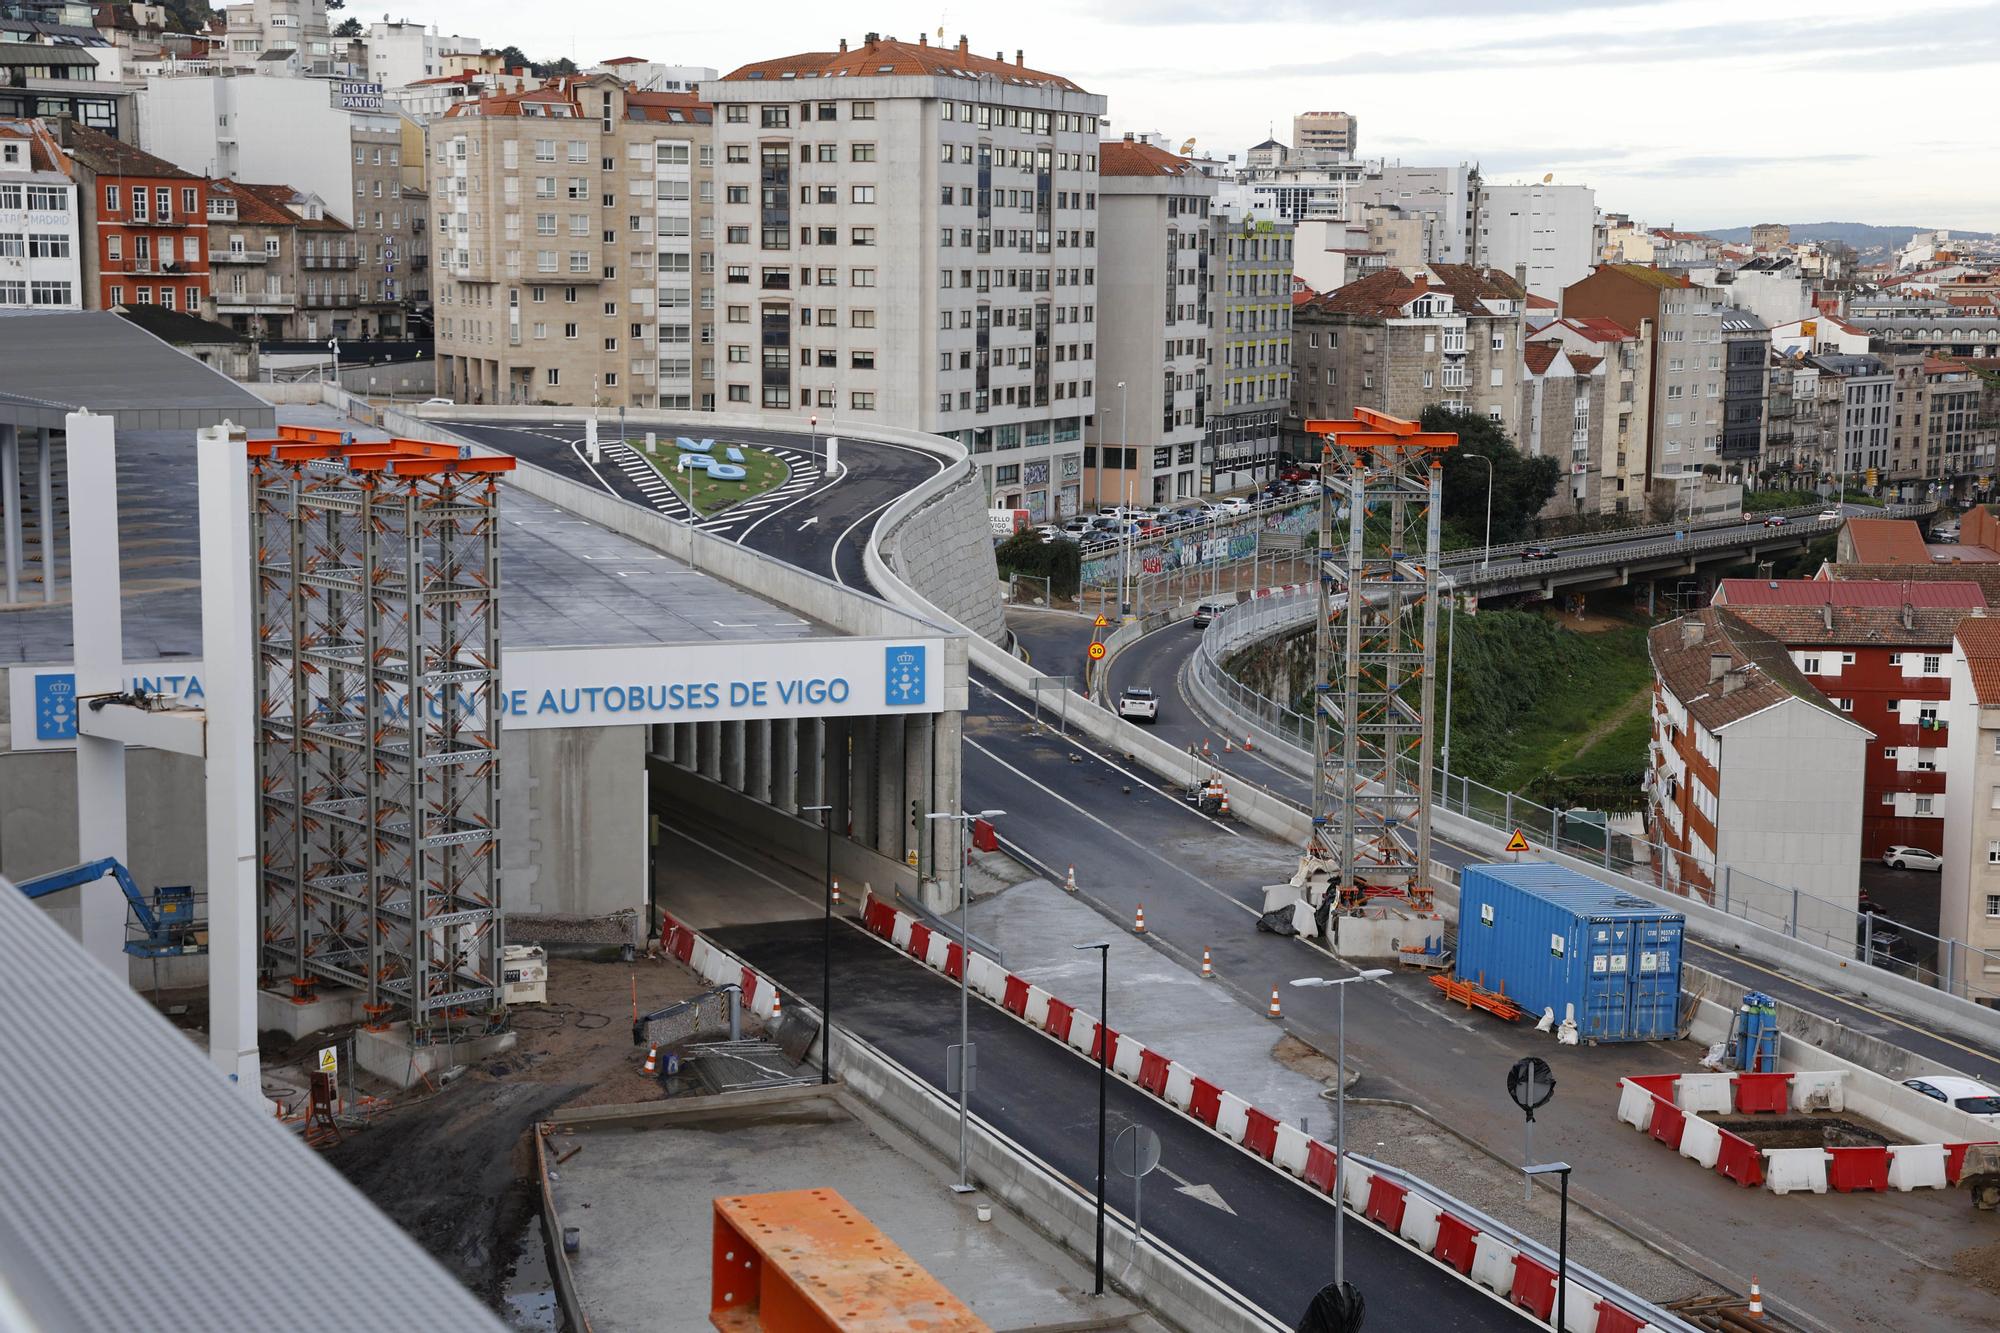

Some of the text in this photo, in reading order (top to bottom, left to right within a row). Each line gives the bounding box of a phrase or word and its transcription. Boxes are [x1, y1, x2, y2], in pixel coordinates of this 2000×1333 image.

[343, 84, 381, 94] HOTEL
[342, 97, 383, 107] PANTON
[31, 214, 69, 225] MADRID
[385, 236, 393, 300] HOTEL
[1092, 647, 1102, 655] 30
[537, 682, 719, 714] AUTOBUSES
[730, 681, 767, 708] DE
[777, 678, 849, 705] VIGO
